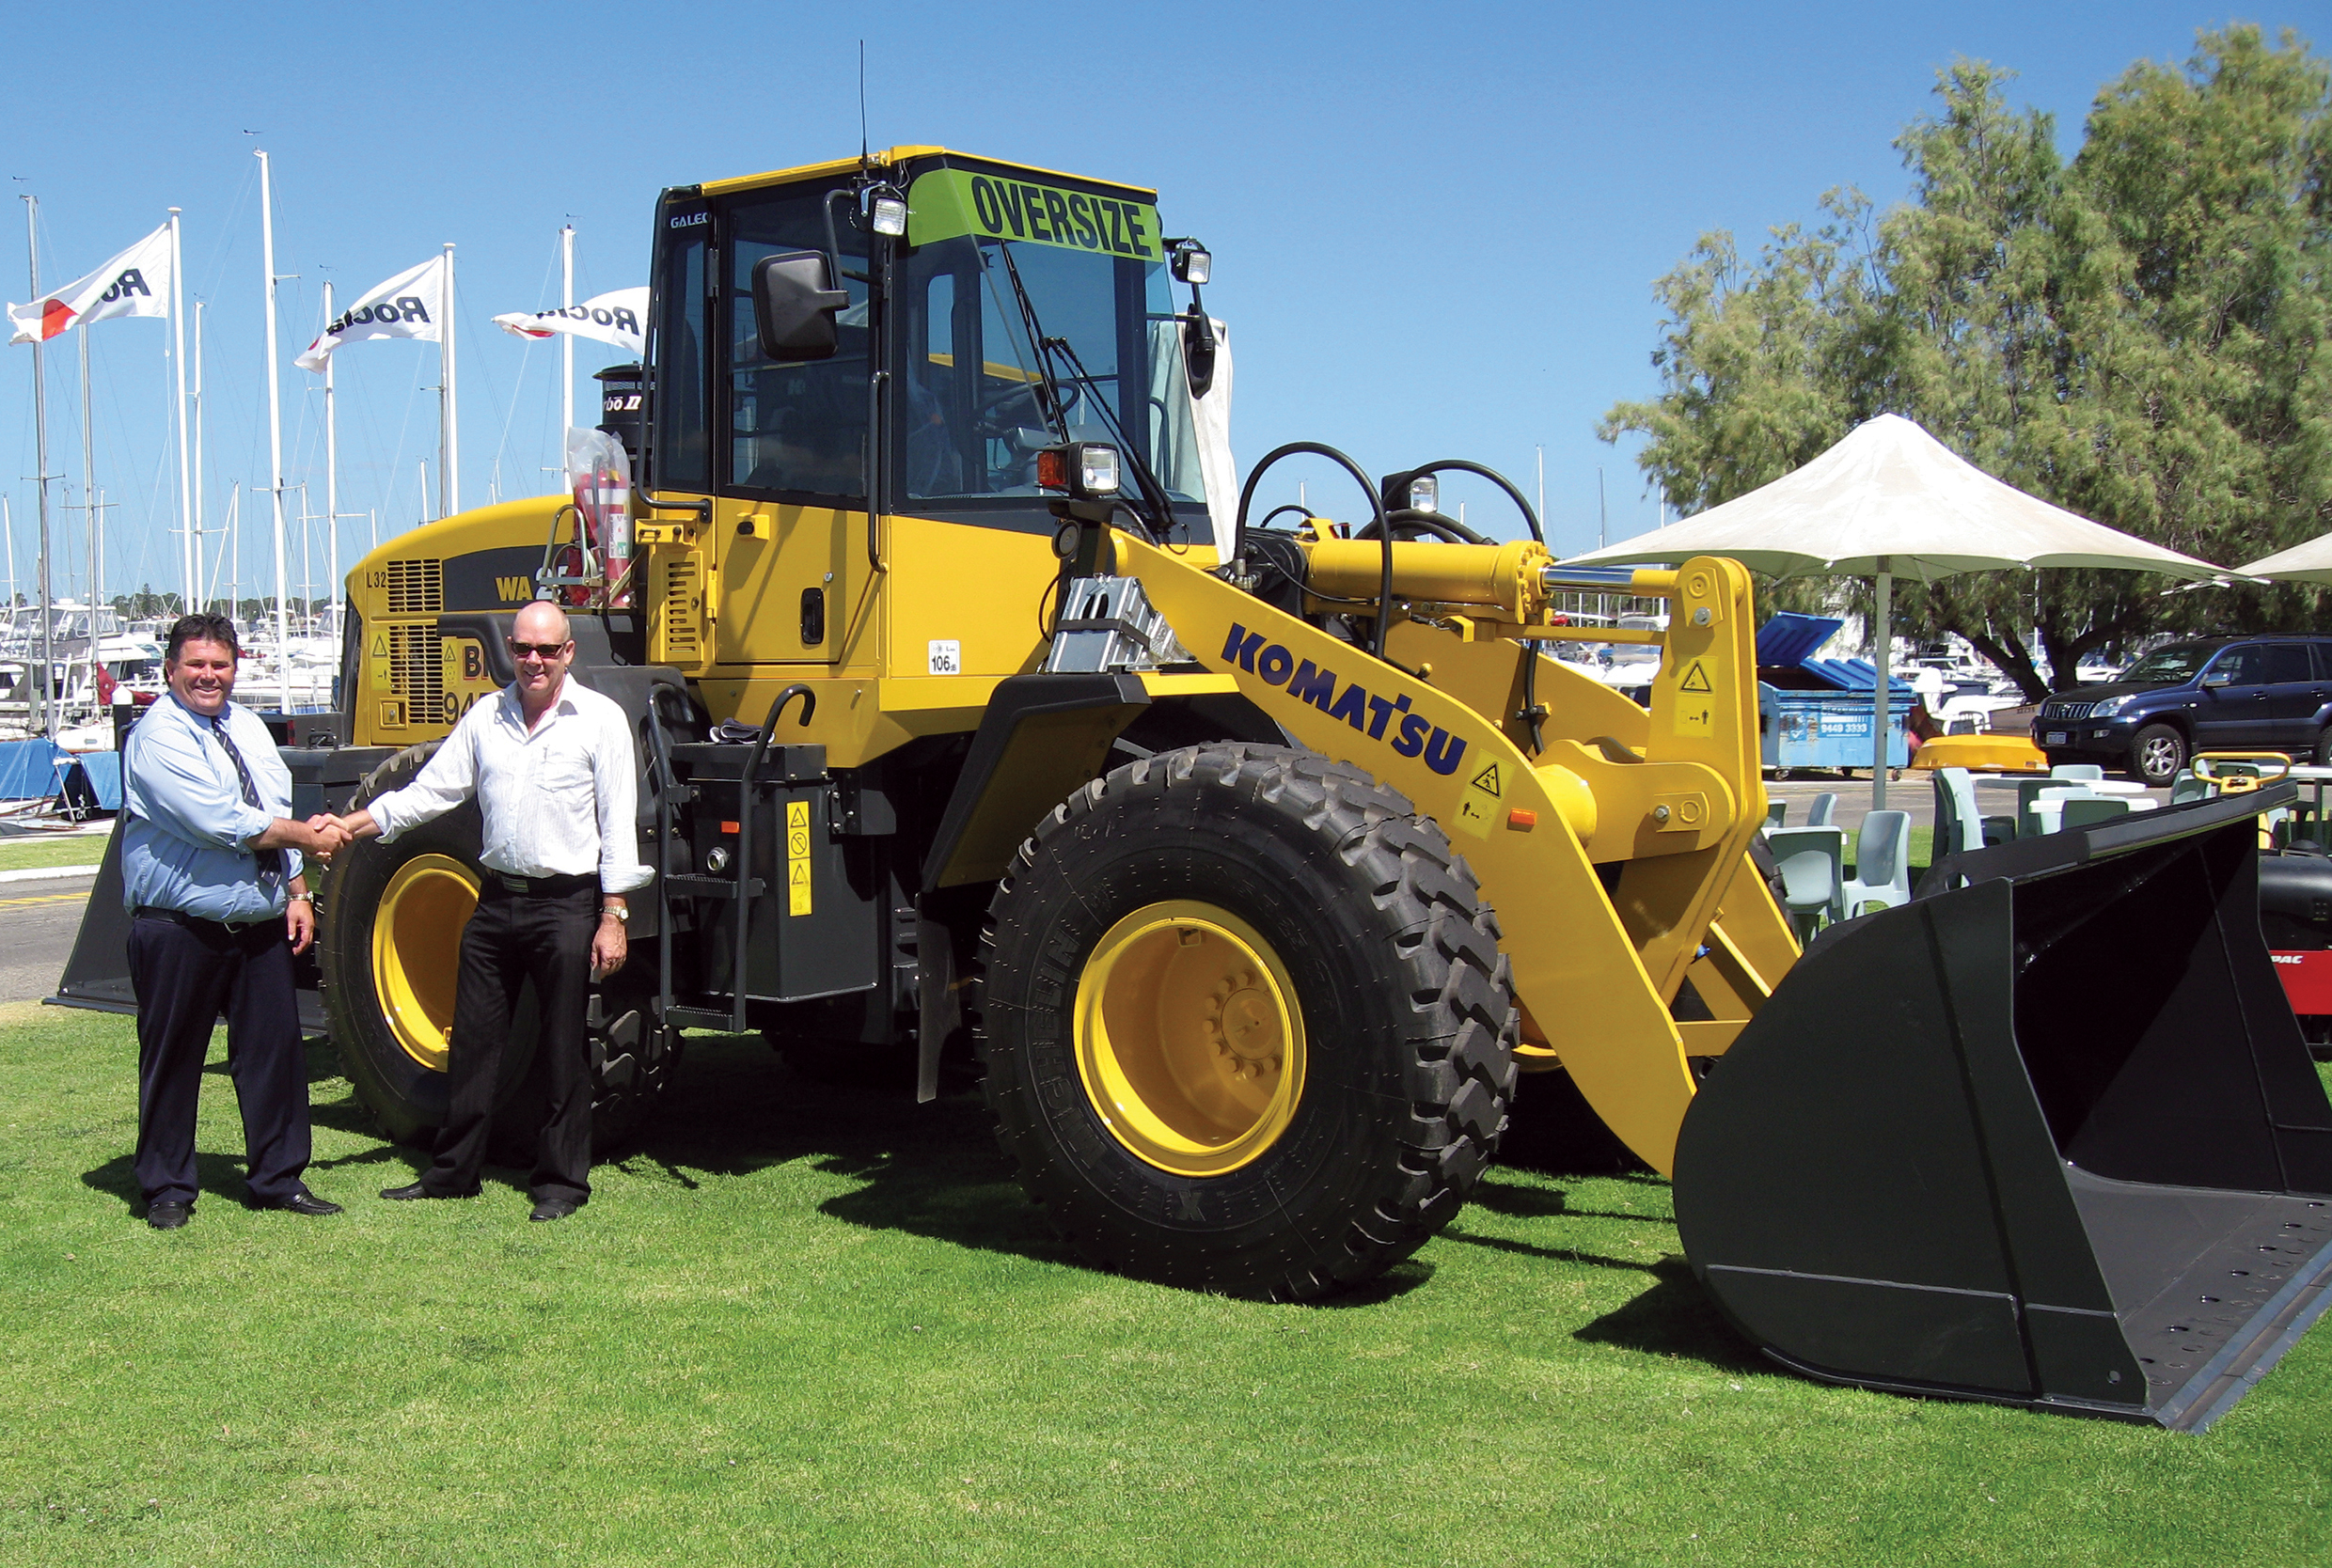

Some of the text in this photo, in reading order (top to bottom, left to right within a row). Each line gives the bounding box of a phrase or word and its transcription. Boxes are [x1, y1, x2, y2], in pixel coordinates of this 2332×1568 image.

[971, 176, 1153, 258] OVERSIZE
[496, 576, 533, 601] WA
[932, 655, 950, 671] 106
[1221, 621, 1468, 776] KOMATSU
[1845, 723, 1867, 733] 3333
[1033, 928, 1108, 1169] MICHELIN
